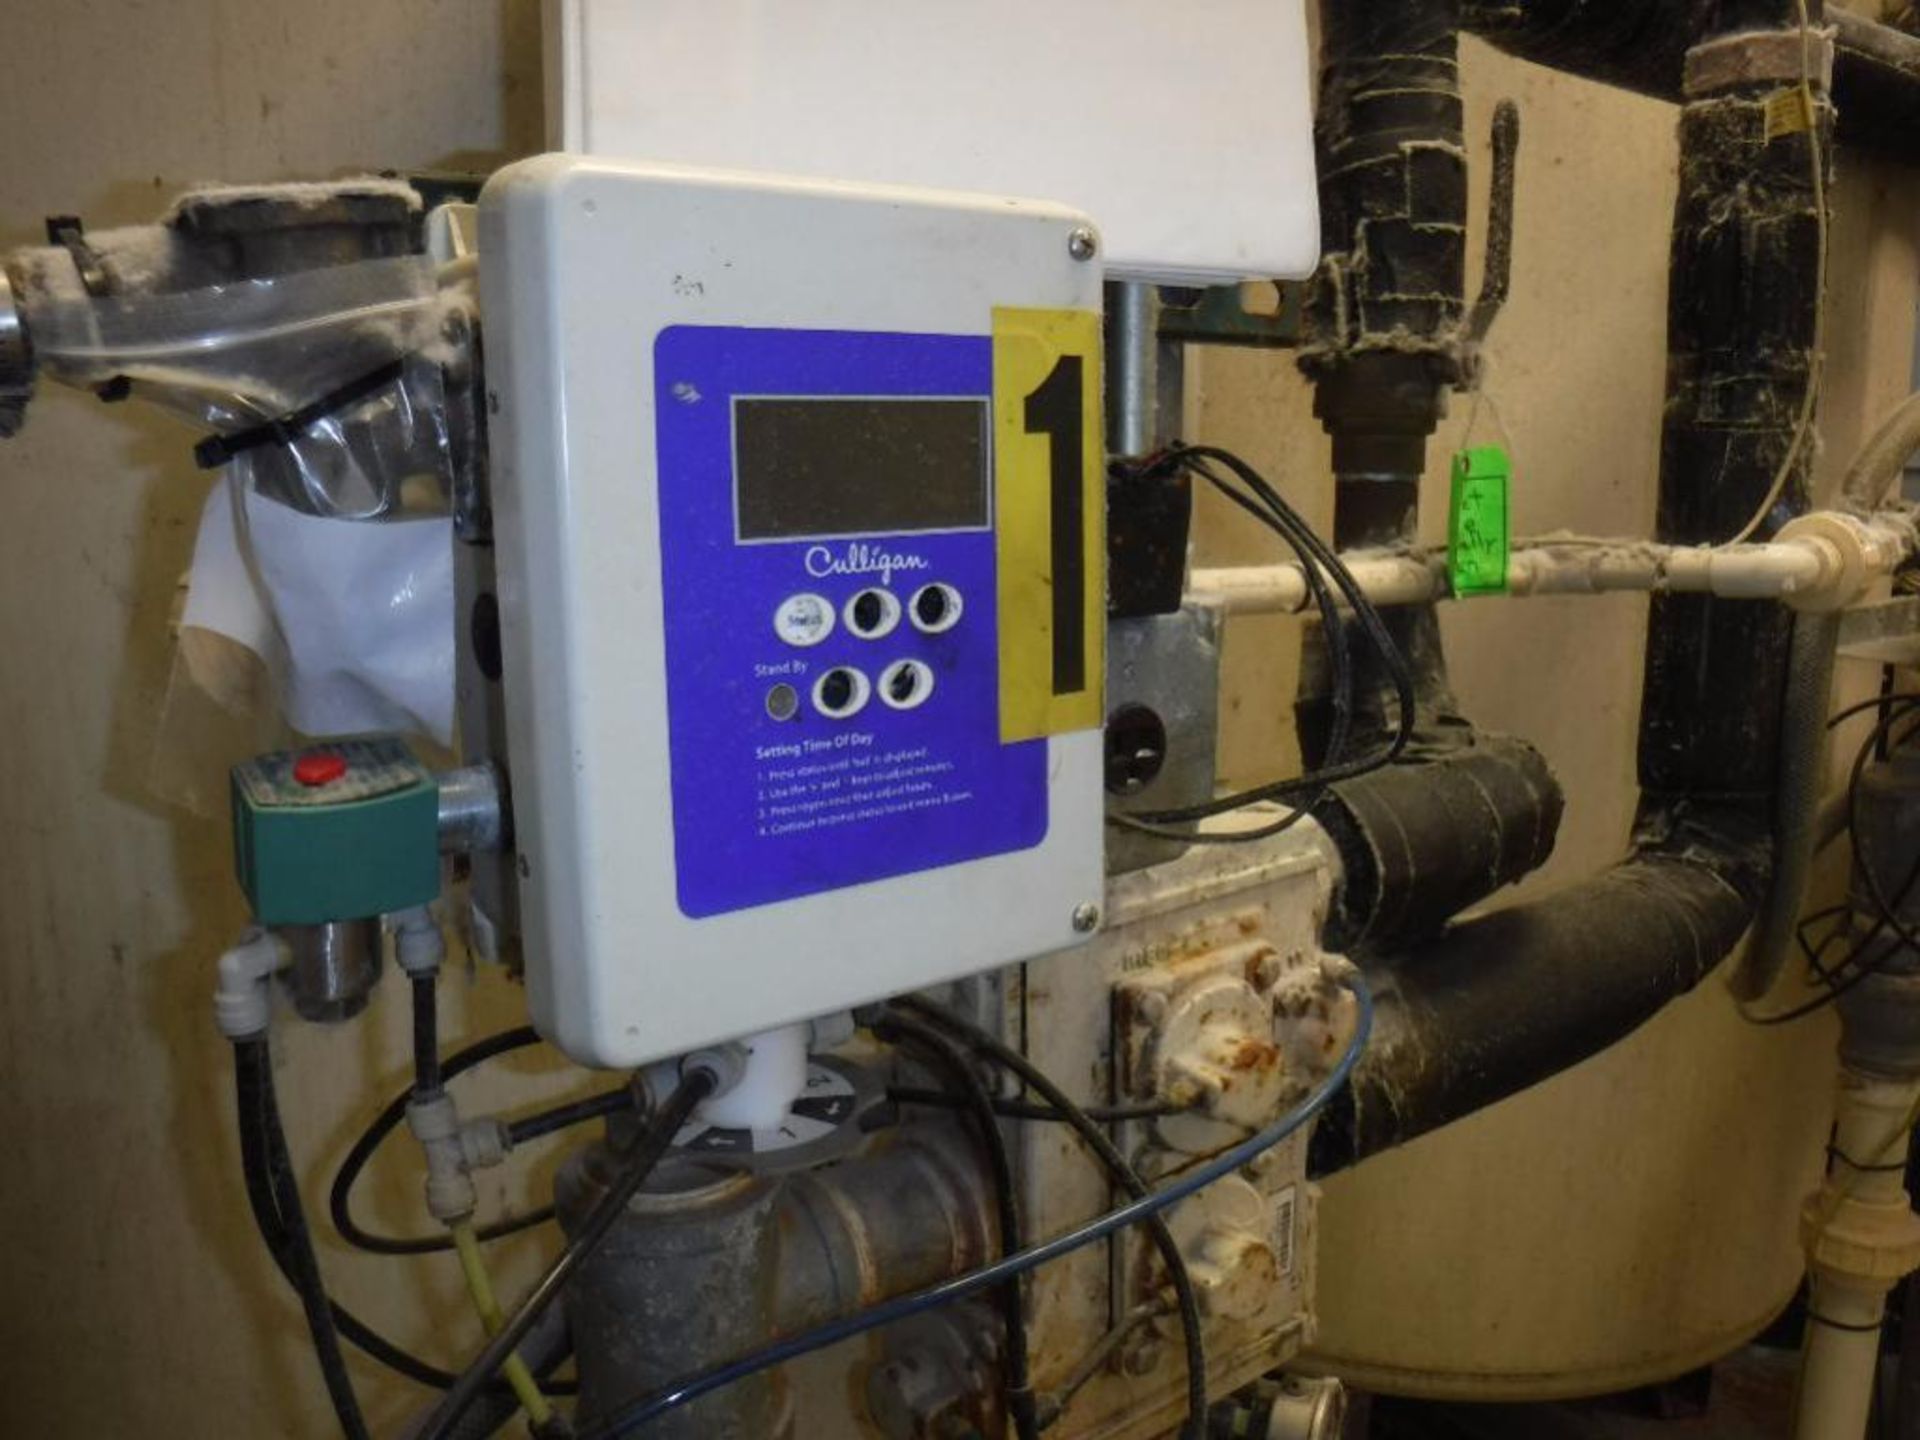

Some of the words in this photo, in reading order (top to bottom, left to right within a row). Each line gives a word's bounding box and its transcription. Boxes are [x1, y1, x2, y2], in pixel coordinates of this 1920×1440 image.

[1024, 355, 1086, 696] 1
[805, 543, 927, 585] Culligan
[754, 664, 790, 678] Stand
[792, 660, 808, 675] By
[756, 742, 801, 760] Setting
[803, 739, 832, 752] Time
[834, 734, 849, 749] Of
[851, 733, 875, 747] Day
